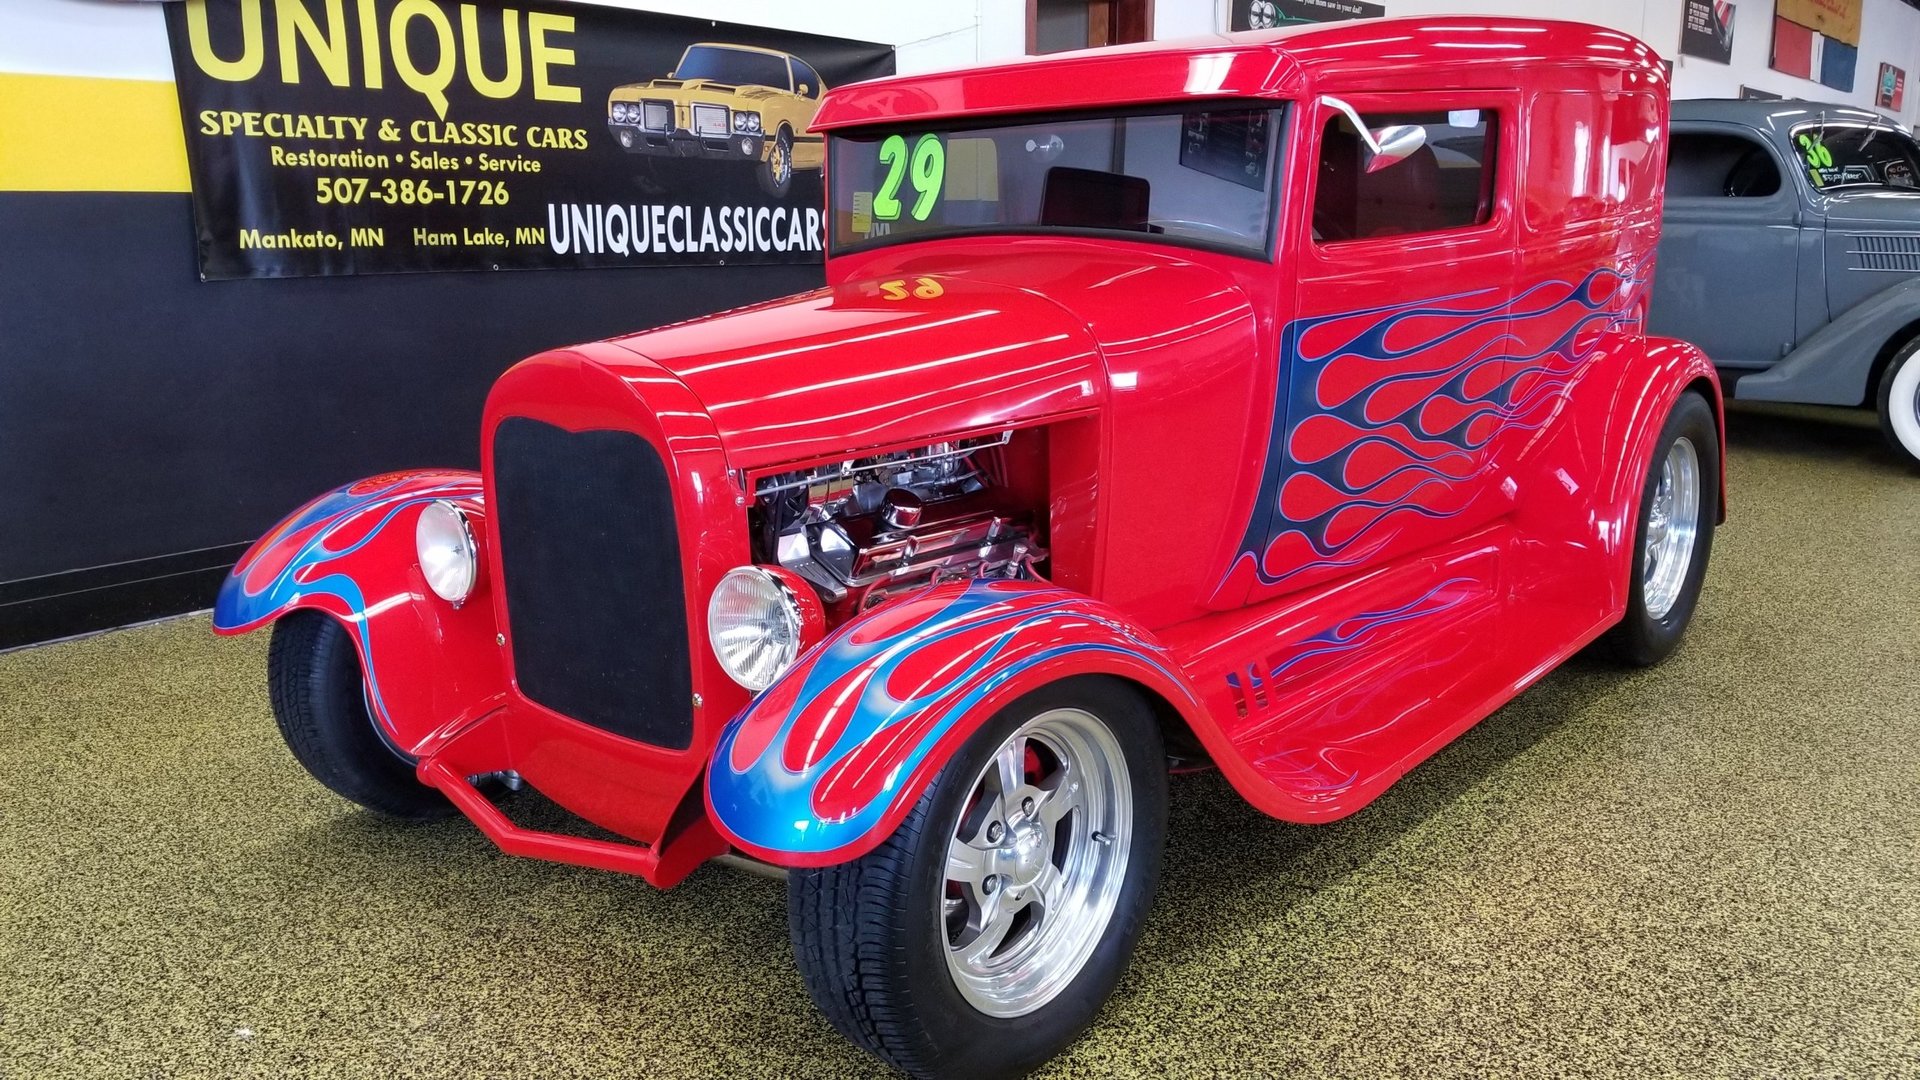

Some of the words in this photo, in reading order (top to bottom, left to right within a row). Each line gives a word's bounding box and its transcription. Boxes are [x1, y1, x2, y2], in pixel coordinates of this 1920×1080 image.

[186, 0, 582, 122] UNIQUE
[199, 110, 368, 140] SPECIALTY
[377, 118, 402, 142] &
[410, 120, 518, 147] CLASSIC
[526, 126, 588, 150] CARS
[270, 145, 389, 169] Restoration
[409, 150, 460, 171] Sales
[478, 153, 542, 173] Service
[1798, 133, 1833, 170] 36
[316, 177, 510, 206] 507-386-1726
[873, 133, 945, 221] 29
[239, 228, 343, 251] Mankato,
[350, 227, 384, 247] MN
[413, 227, 458, 246] Ham
[463, 227, 510, 248] Lake,
[515, 227, 545, 245] MN
[548, 203, 826, 257] UNIQUECLASSICCAR
